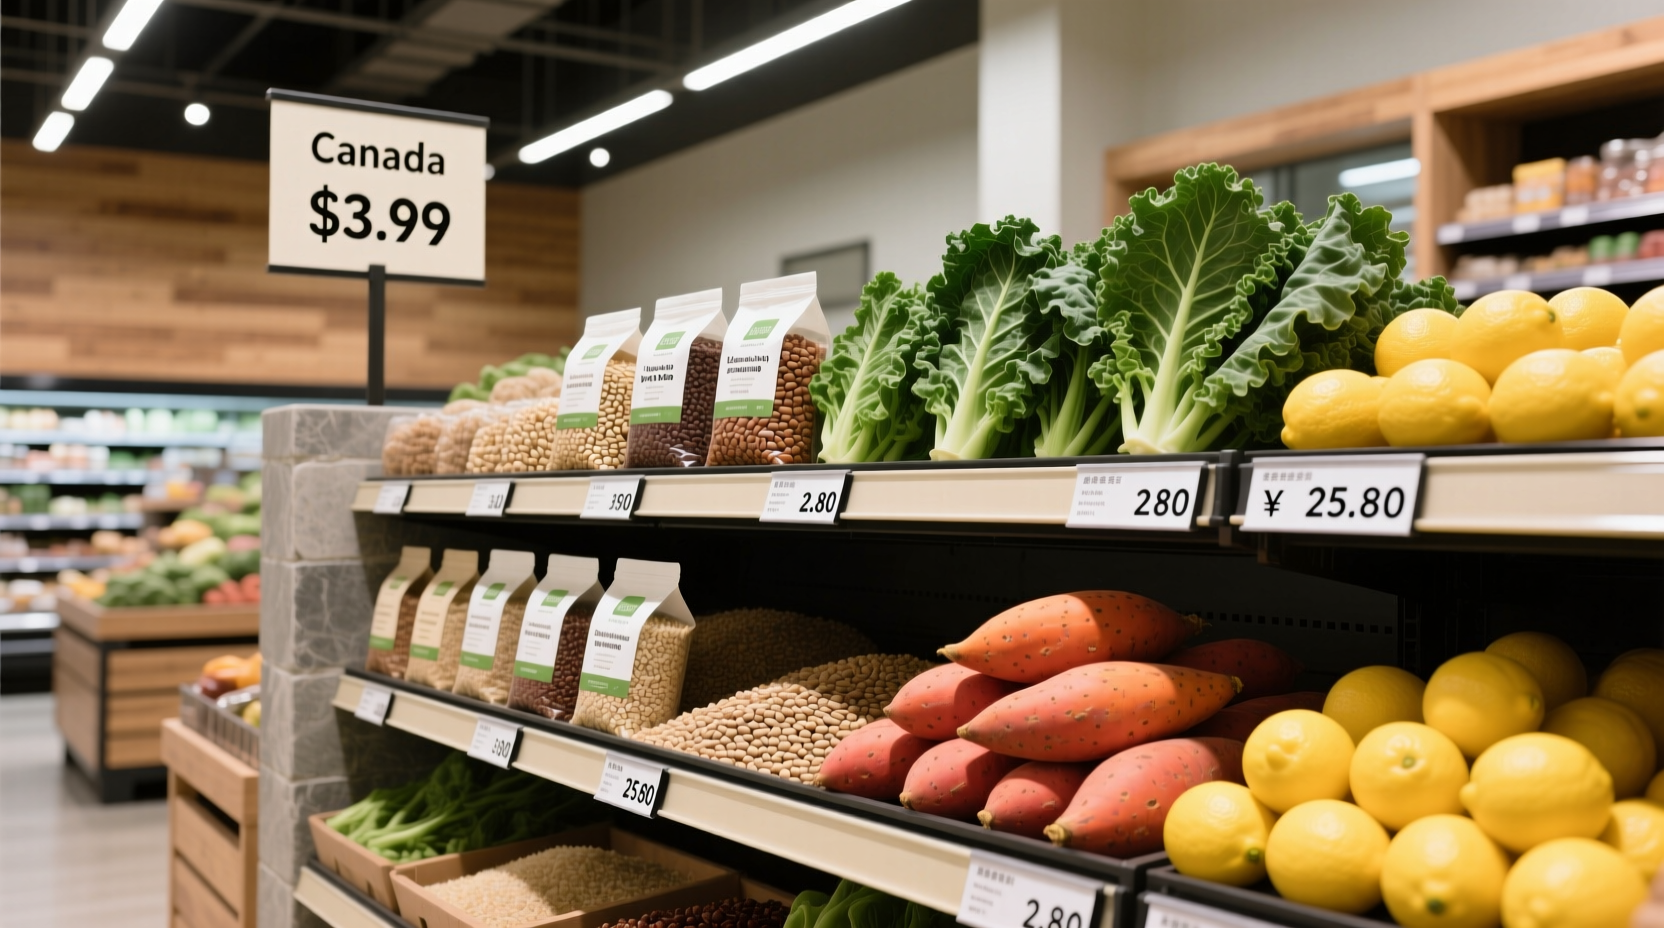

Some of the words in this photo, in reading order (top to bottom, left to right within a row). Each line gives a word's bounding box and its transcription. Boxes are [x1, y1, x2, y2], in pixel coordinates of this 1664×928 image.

[311, 131, 444, 176] Canada
[309, 185, 451, 246] $3.99
[799, 491, 837, 514] 2.80
[1134, 489, 1190, 517] 280
[1264, 489, 1284, 518] ¥
[1306, 487, 1405, 519] 25.80
